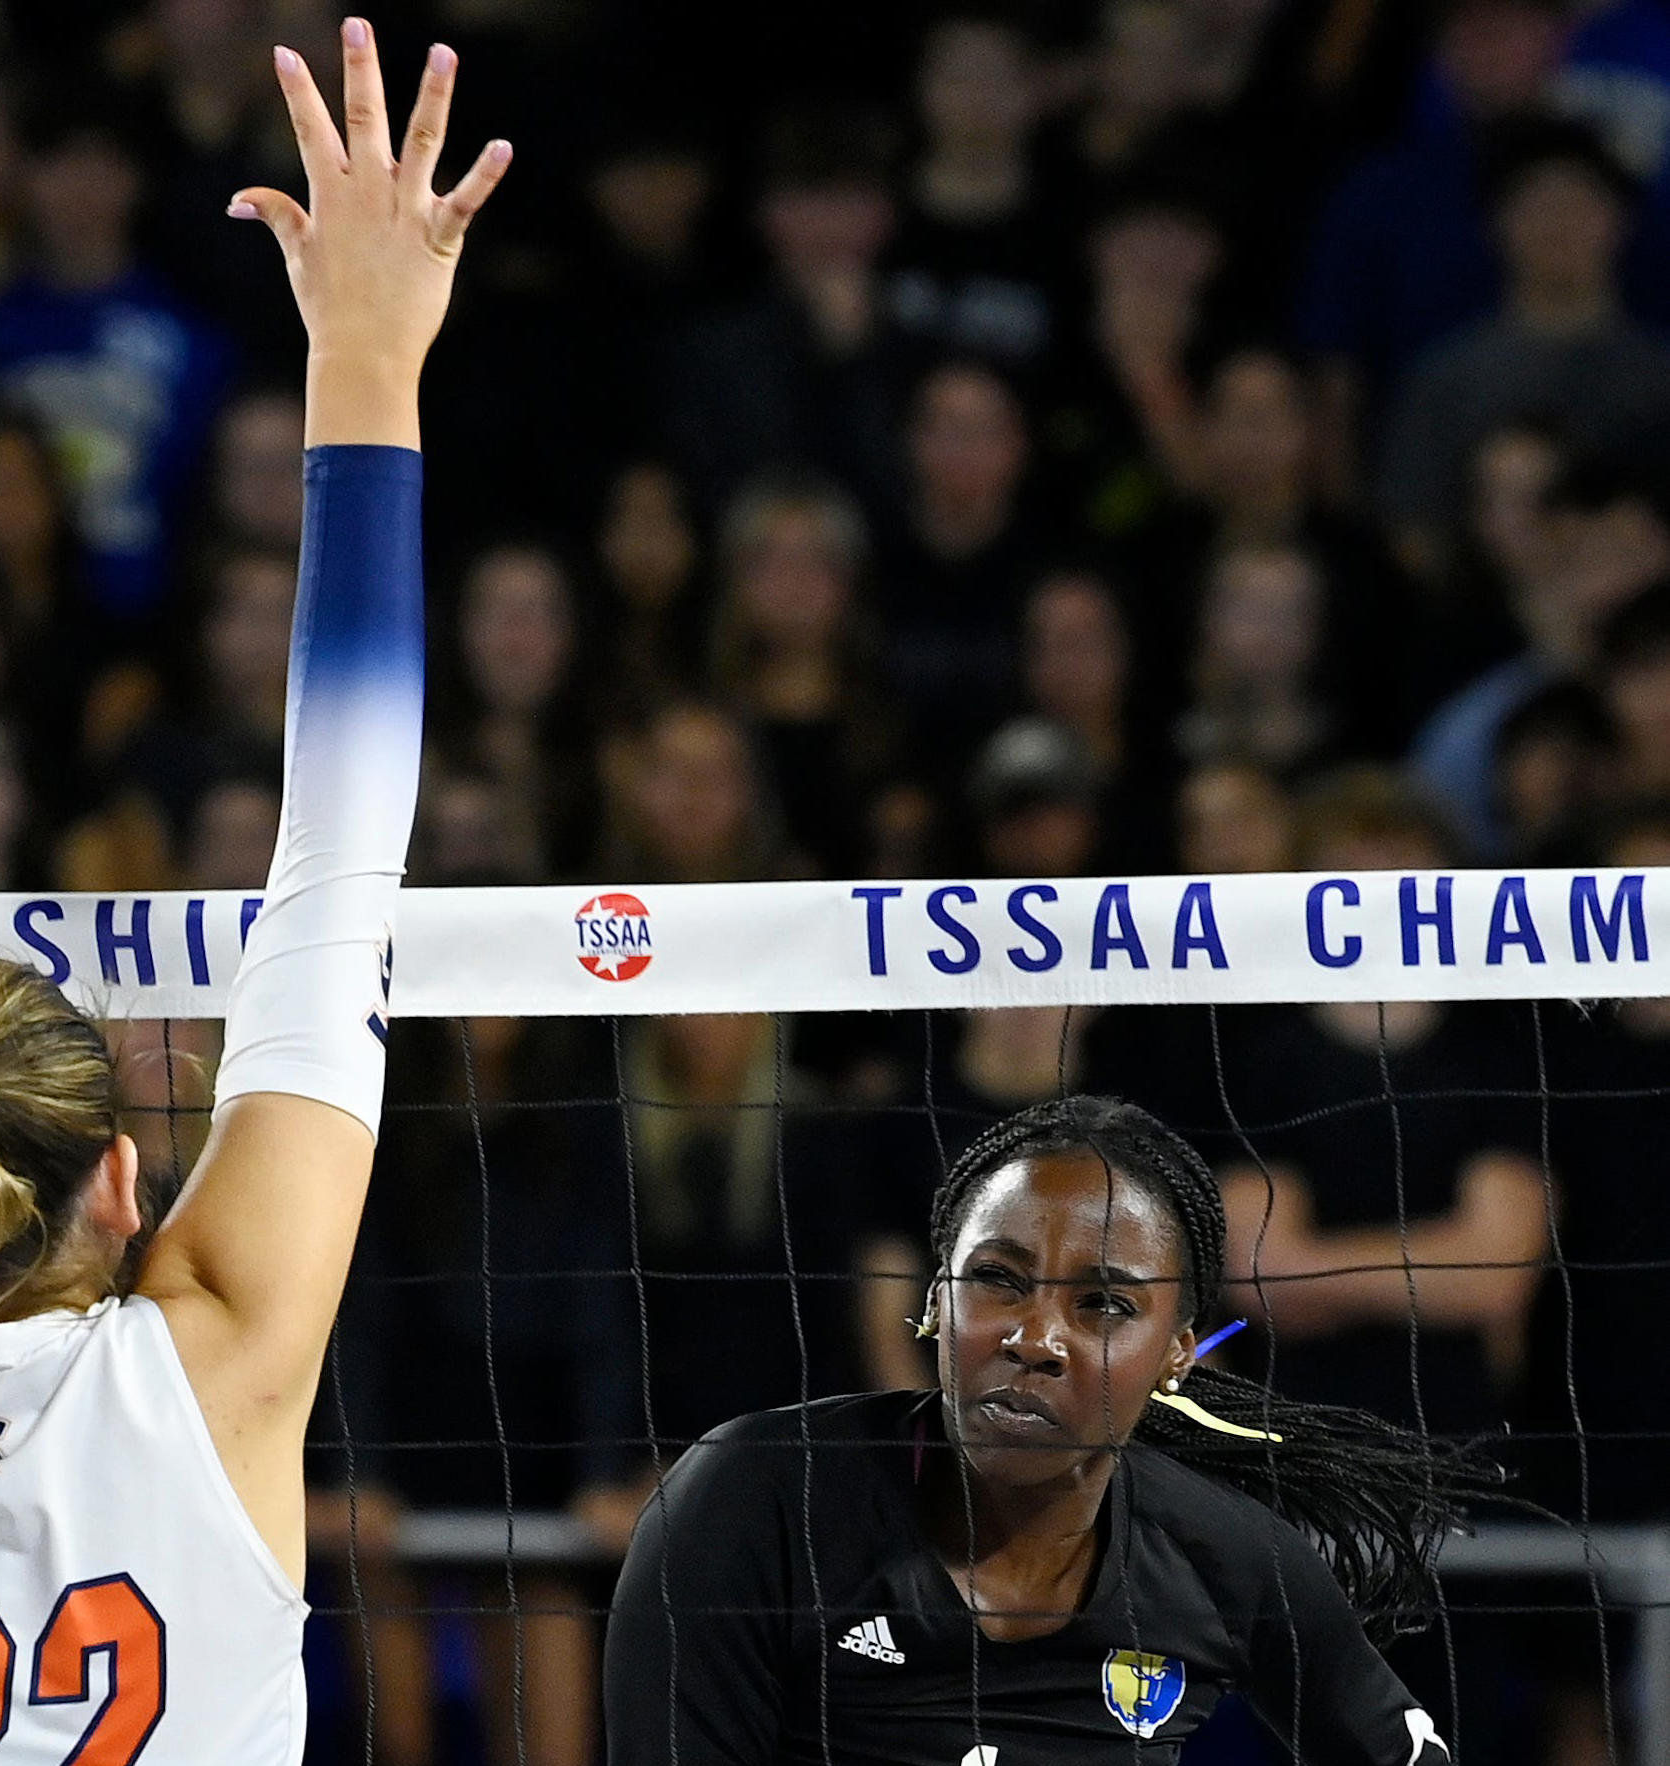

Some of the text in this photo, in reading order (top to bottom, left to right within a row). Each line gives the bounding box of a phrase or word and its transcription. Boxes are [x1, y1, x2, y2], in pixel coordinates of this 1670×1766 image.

[575, 917, 652, 948] TSSAA
[851, 874, 1649, 976] TSSAA CHAM
[837, 1635, 906, 1665] adidas
